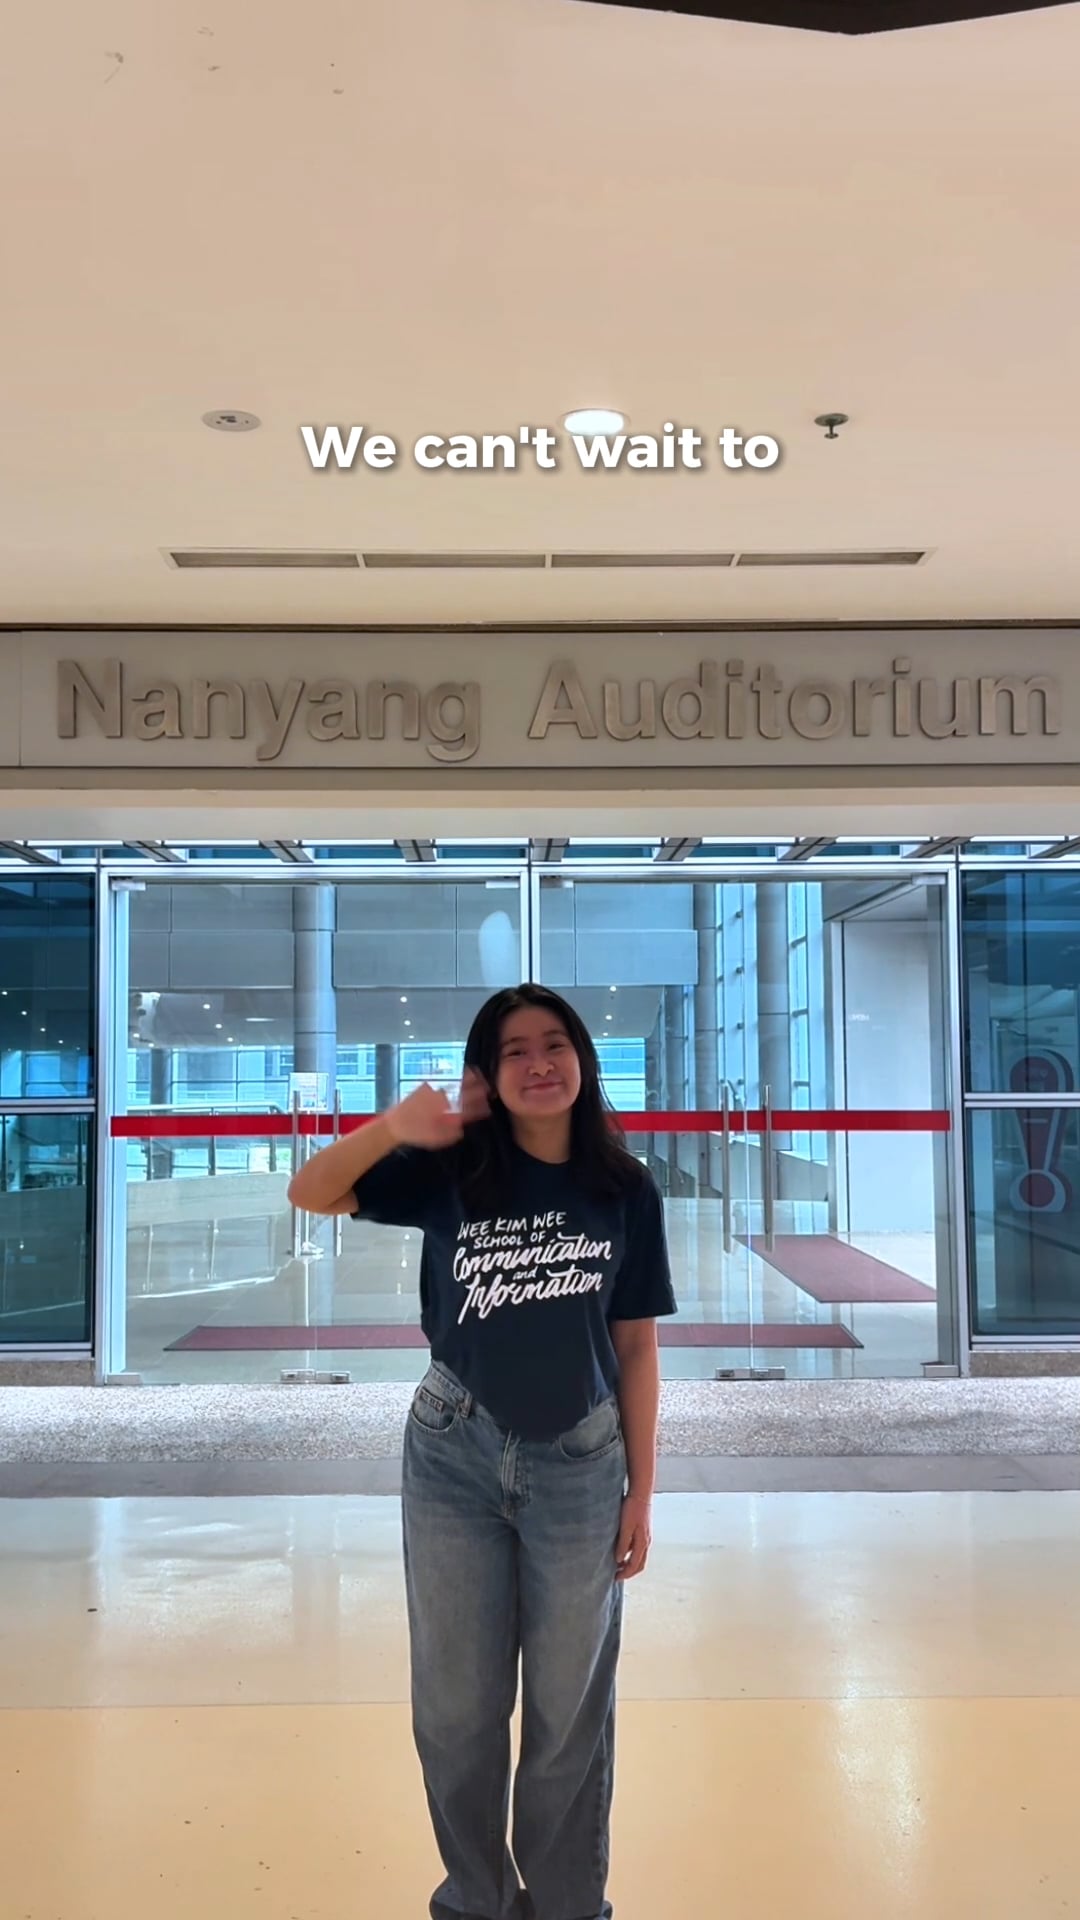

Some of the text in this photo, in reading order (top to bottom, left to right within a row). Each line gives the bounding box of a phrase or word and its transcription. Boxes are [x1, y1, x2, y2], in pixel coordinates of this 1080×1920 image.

[57, 656, 1059, 763] Nanyang Auditorium
[457, 1211, 566, 1240] WEE KIM WEE
[473, 1231, 546, 1249] SCHOOL OF
[453, 1232, 612, 1282] Communication
[513, 1266, 538, 1280] and
[457, 1264, 603, 1325] Information
